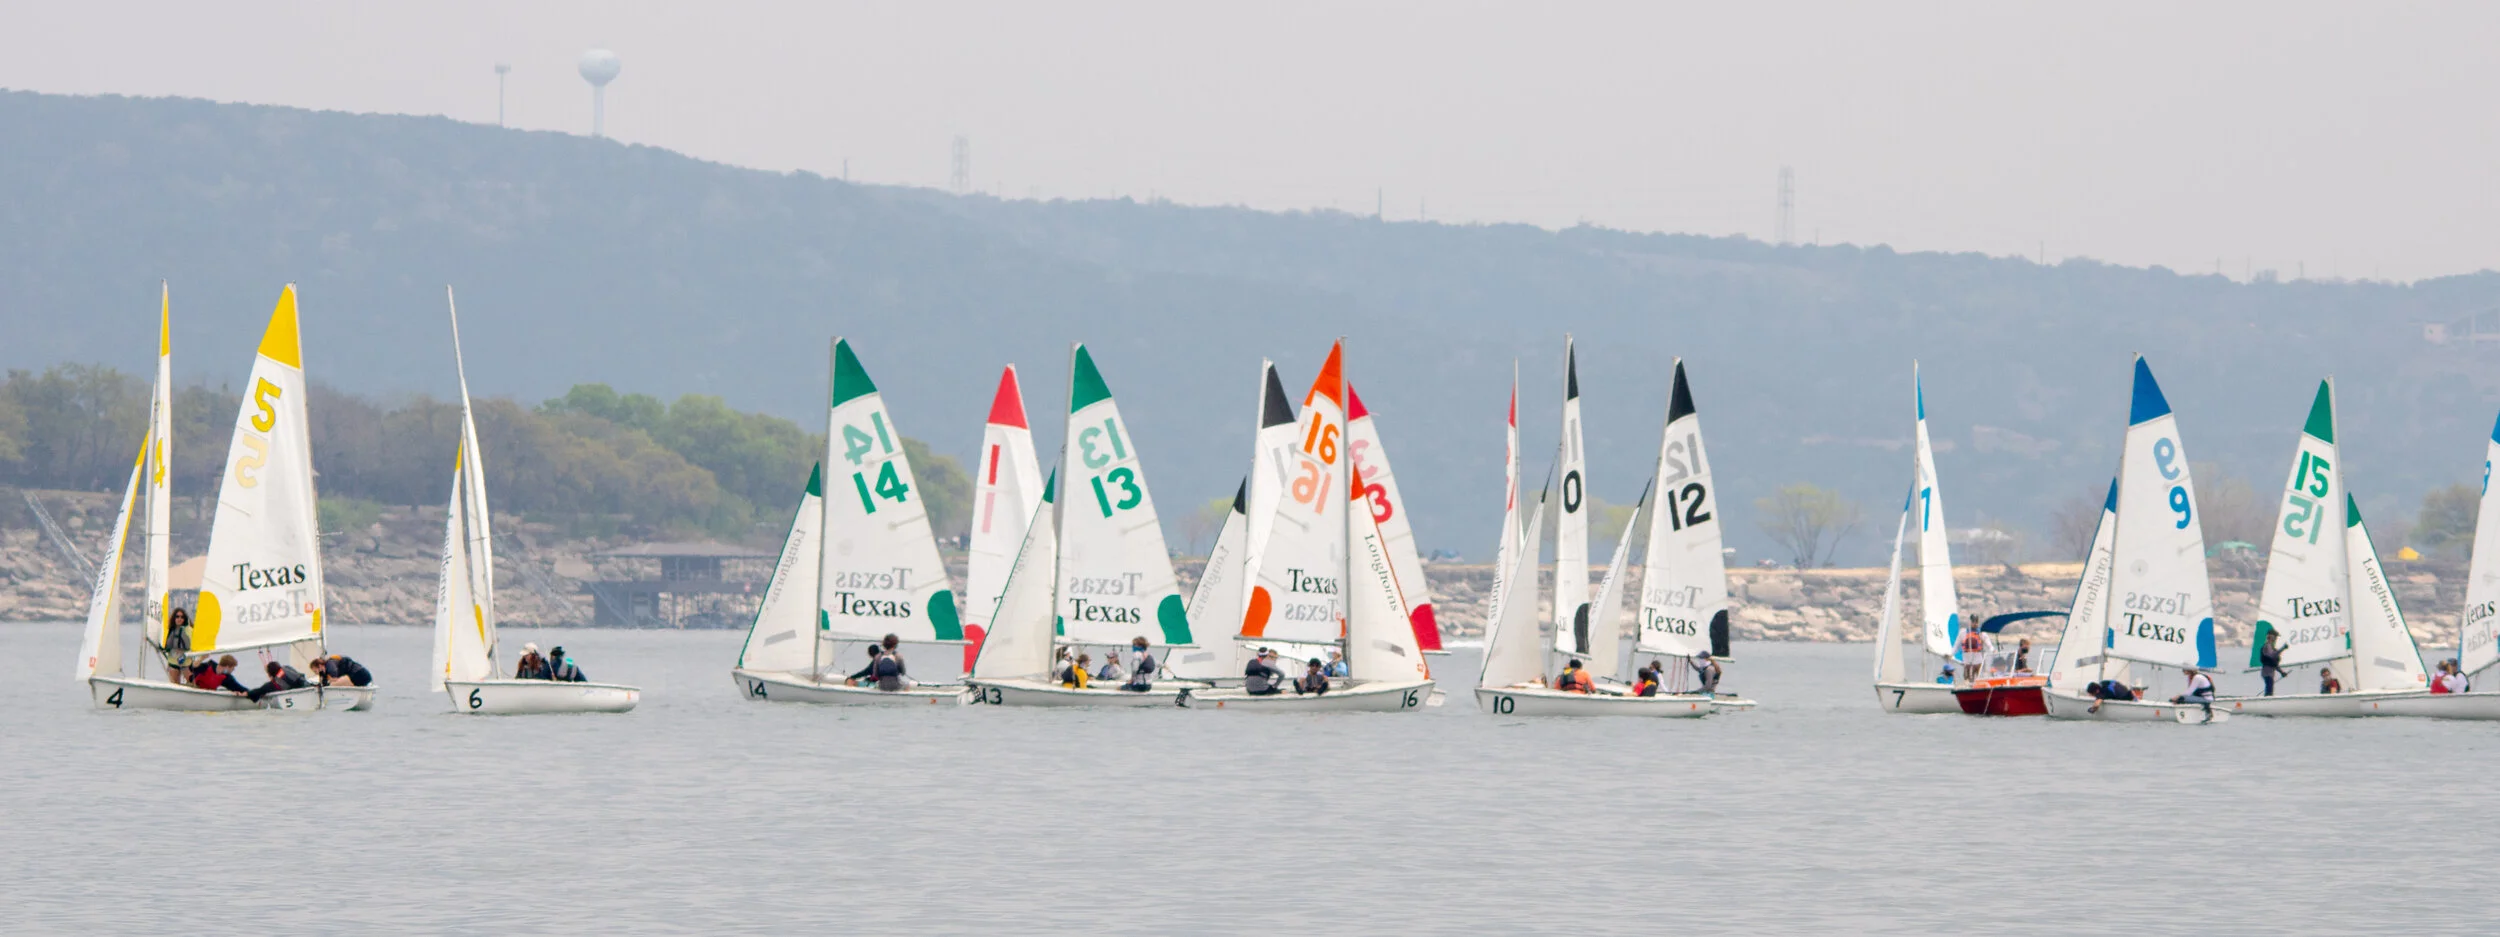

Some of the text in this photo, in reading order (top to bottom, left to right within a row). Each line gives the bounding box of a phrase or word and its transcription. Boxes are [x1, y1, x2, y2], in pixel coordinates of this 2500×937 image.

[251, 377, 281, 432] 5
[1303, 412, 1340, 465] 16
[154, 437, 165, 488] 4
[2294, 450, 2331, 498] 15
[853, 460, 909, 515] 14
[1090, 467, 1143, 519] 13
[1364, 483, 1393, 524] 3
[1668, 482, 1711, 532] 12
[2169, 485, 2191, 530] 9
[232, 562, 306, 592] Texas
[1286, 567, 1338, 595] Texas
[1364, 533, 1398, 611] Longhorns
[834, 591, 911, 618] Texas
[2287, 596, 2341, 620] Texas
[2362, 557, 2397, 629] Longhorns
[1069, 597, 1141, 624] Texas
[1644, 607, 1697, 637] Texas
[2123, 612, 2186, 645] Texas
[106, 687, 124, 708] 4
[285, 698, 294, 708] 5
[469, 688, 482, 709] 6
[750, 681, 768, 699] 14
[982, 688, 1003, 705] 13
[1401, 689, 1418, 707] 16
[1493, 696, 1515, 714] 10
[1893, 690, 1905, 708] 7
